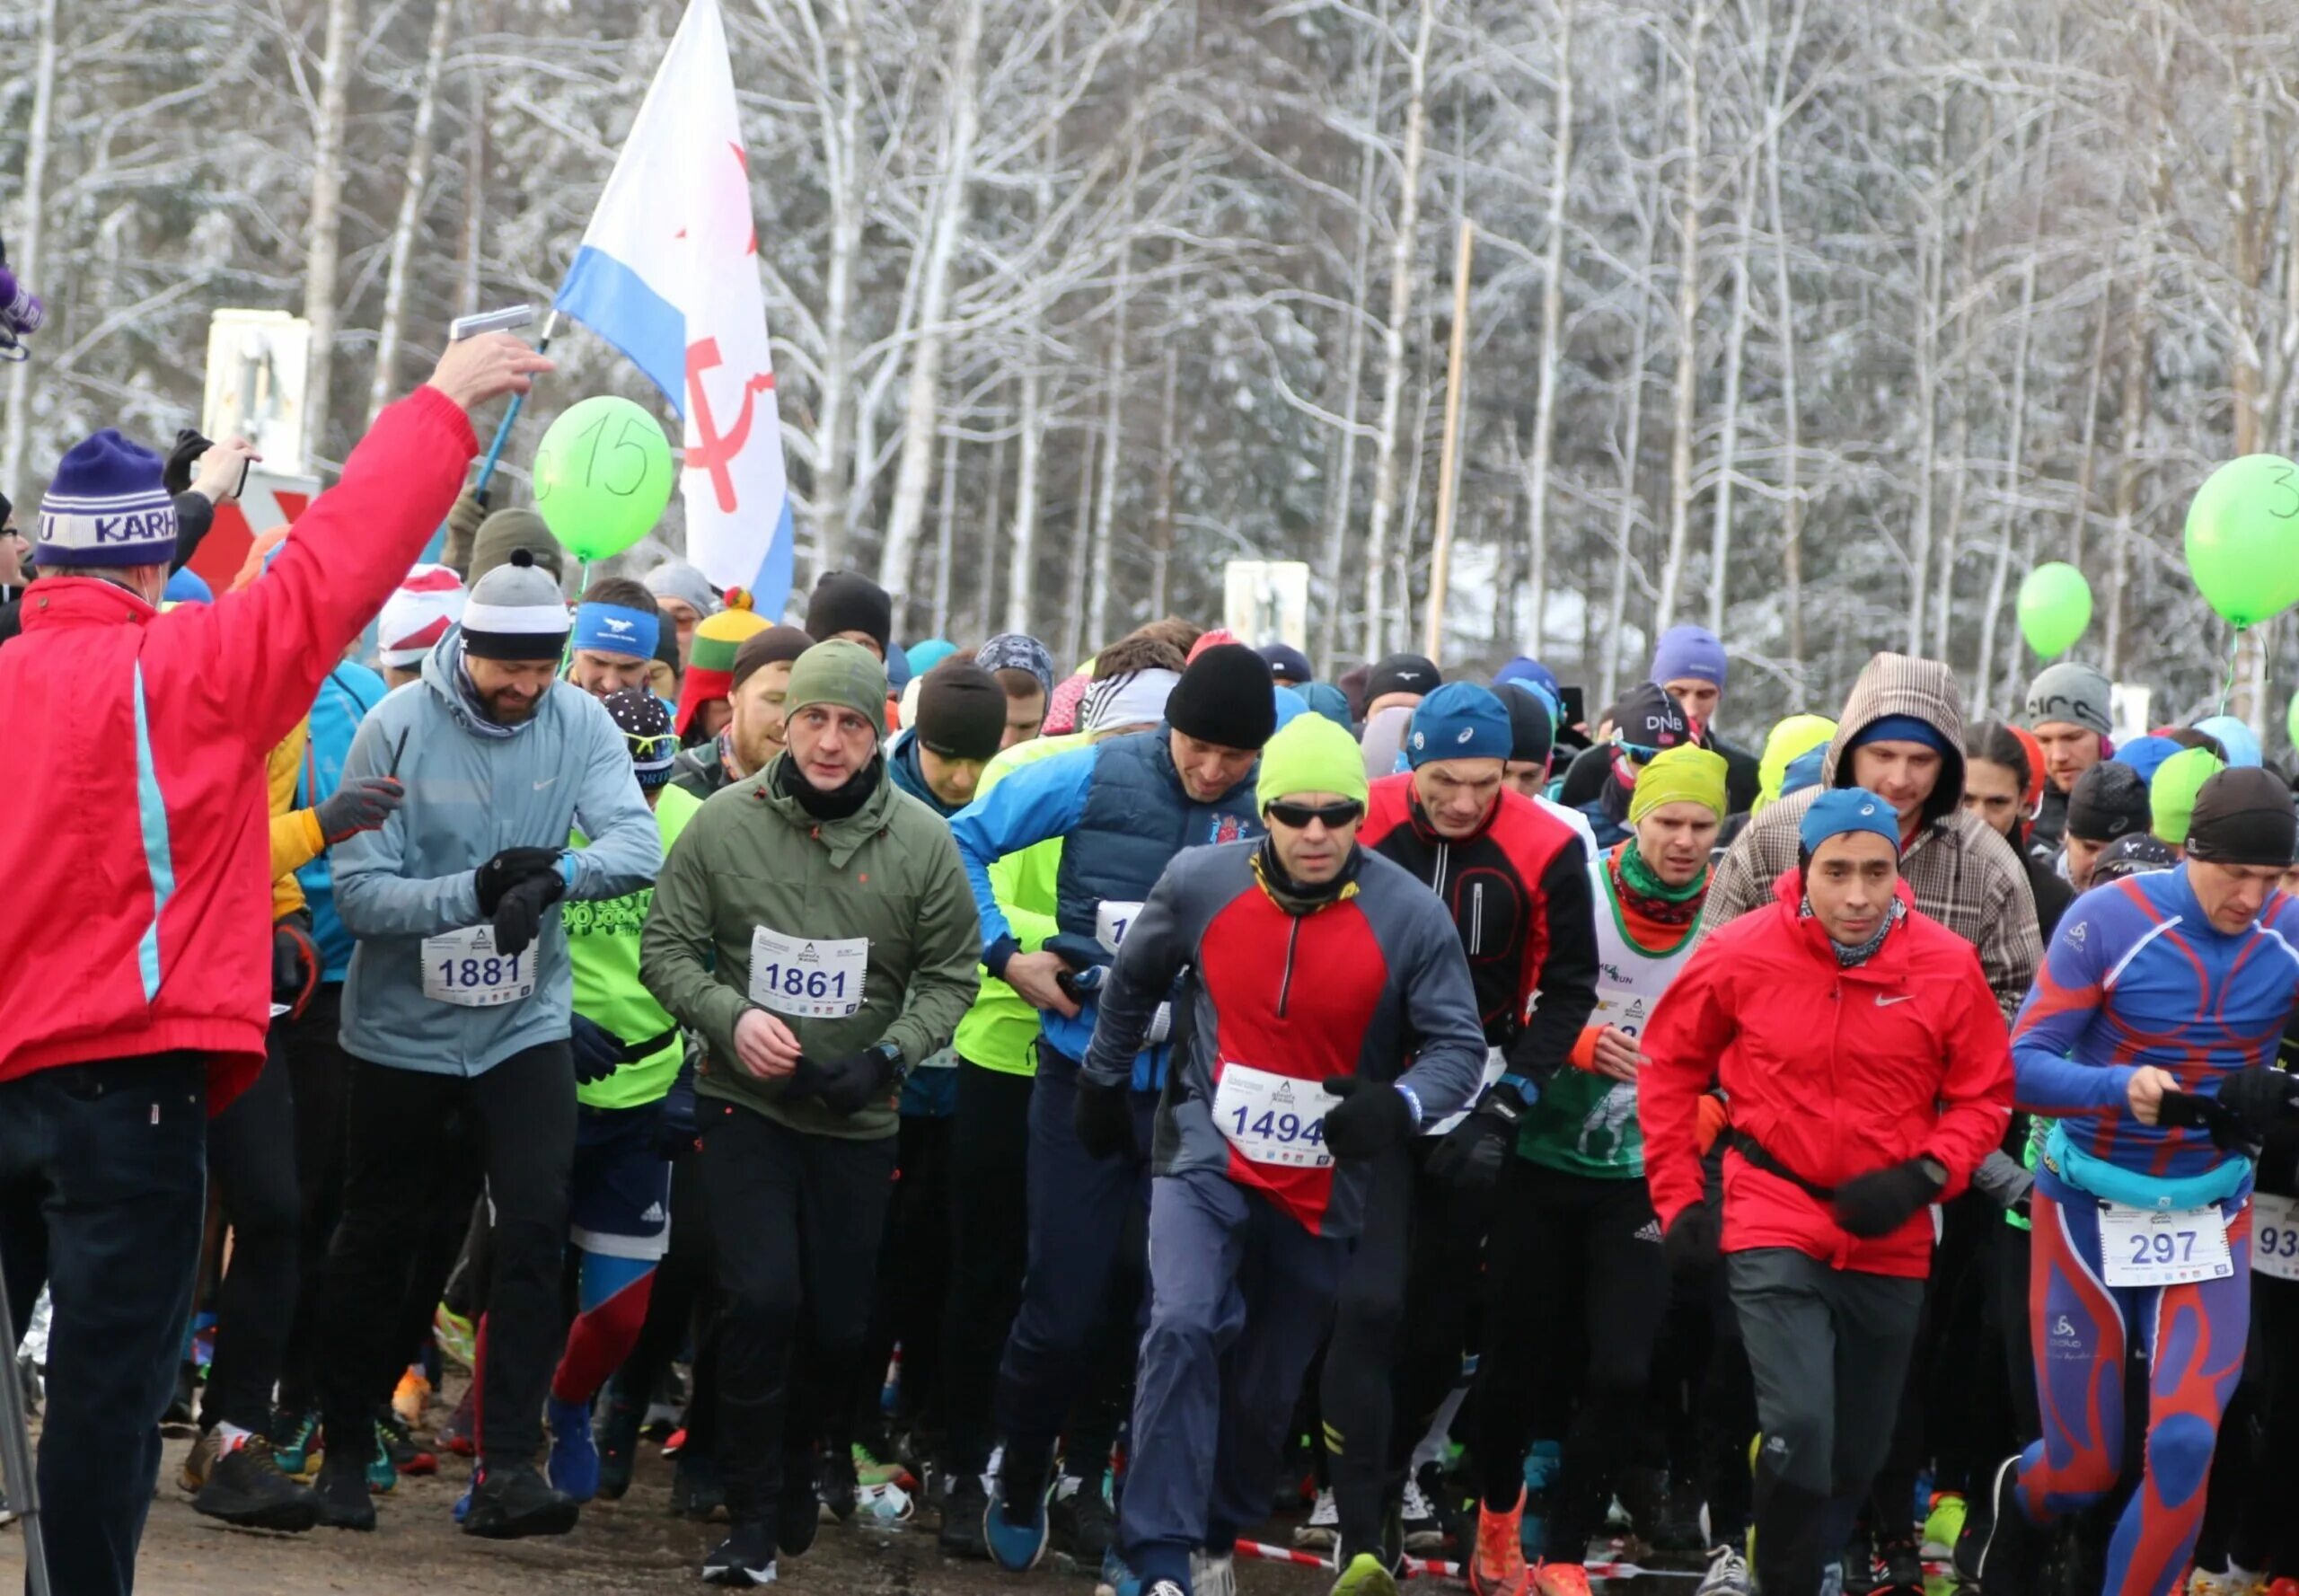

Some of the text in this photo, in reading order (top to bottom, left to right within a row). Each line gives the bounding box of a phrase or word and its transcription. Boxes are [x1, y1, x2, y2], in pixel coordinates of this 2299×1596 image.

[577, 410, 662, 497] 15
[1646, 715, 1683, 732] DNB
[438, 956, 519, 988] 1881
[765, 963, 846, 999] 1861
[1231, 1105, 1326, 1148] 1494
[2129, 1230, 2198, 1265] 297
[2259, 1226, 2299, 1258] 93
